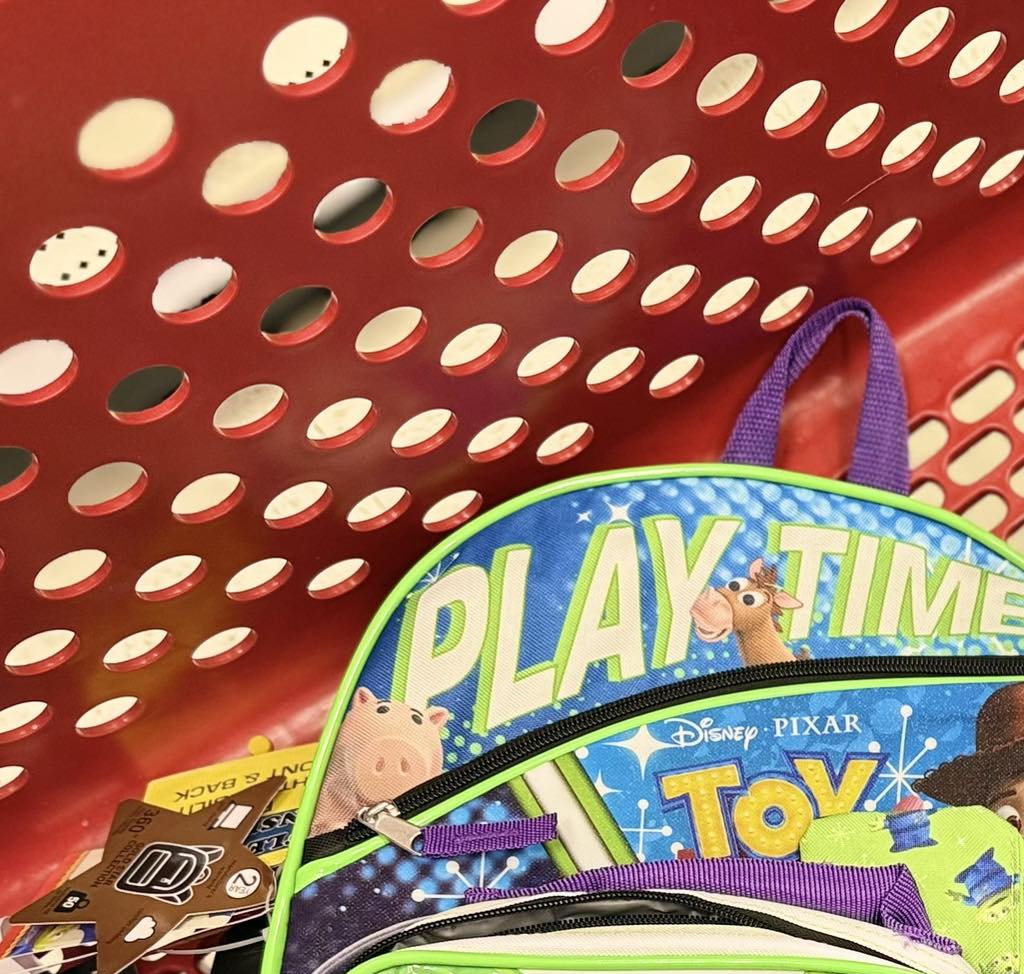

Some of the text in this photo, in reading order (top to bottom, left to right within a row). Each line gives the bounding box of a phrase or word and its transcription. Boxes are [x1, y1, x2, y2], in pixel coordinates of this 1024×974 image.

[390, 514, 742, 734] PLAY
[664, 714, 862, 750] Disney PIXAR
[174, 777, 237, 802] BACK
[236, 872, 258, 887] 2
